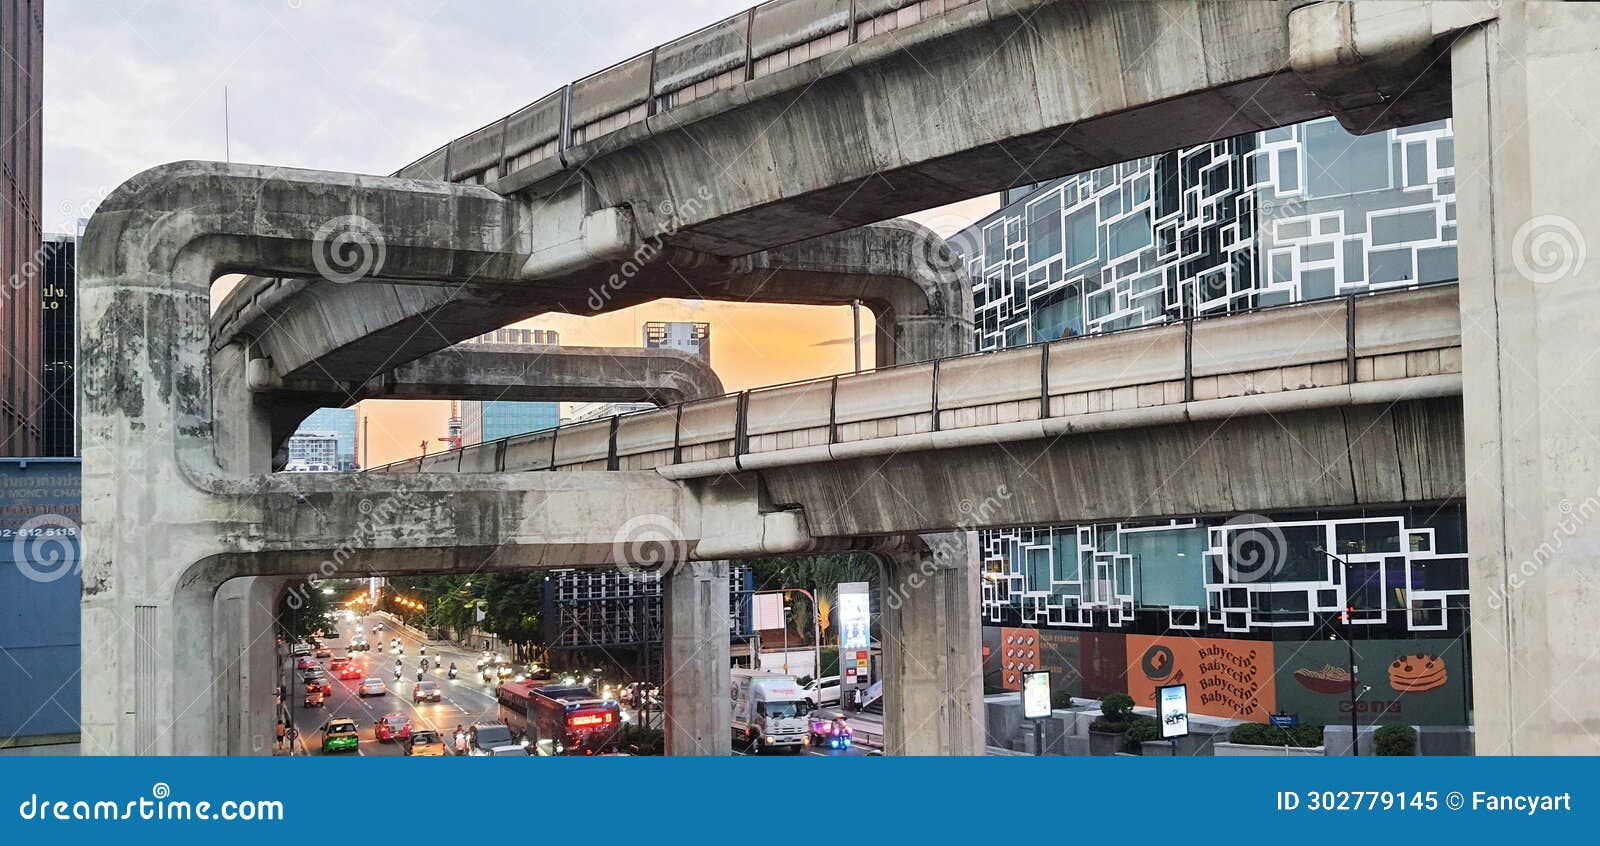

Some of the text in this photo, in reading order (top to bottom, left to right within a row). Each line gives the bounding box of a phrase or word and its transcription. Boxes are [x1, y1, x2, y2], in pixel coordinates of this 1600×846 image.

[0, 528, 43, 537] 2-612
[1198, 644, 1256, 667] Babyccino
[1199, 659, 1257, 683] Babyccino
[1200, 675, 1258, 699] Babyccino
[1200, 690, 1259, 715] Babyccino
